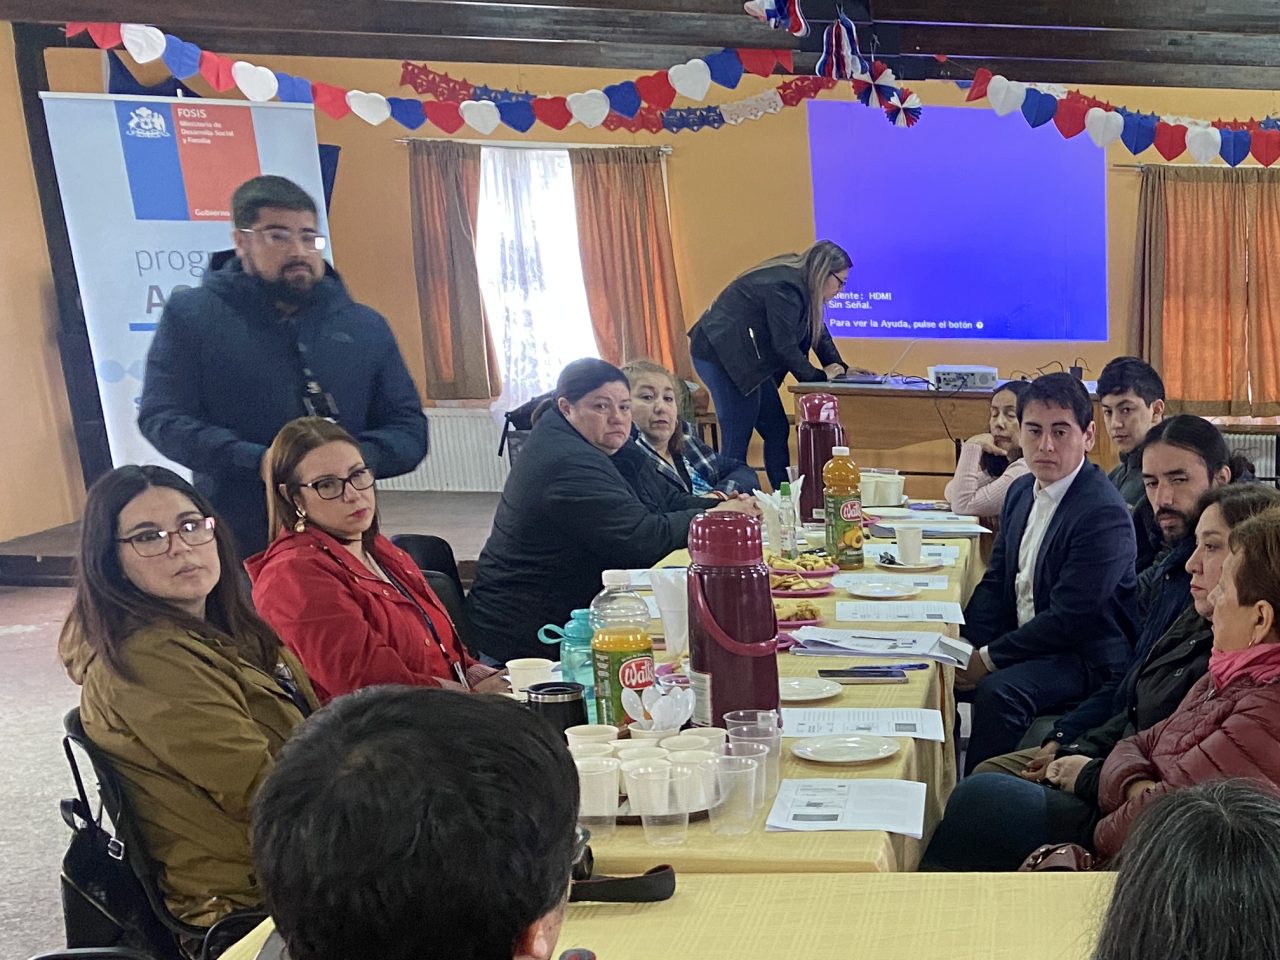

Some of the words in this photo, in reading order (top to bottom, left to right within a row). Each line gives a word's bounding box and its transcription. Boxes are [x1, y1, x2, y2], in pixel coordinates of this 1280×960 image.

[177, 107, 207, 119] FOSIS
[194, 208, 231, 217] Gobierno
[135, 249, 209, 277] prog
[869, 292, 892, 301] HDMI
[828, 300, 843, 309] Sin
[829, 318, 851, 328] Para
[853, 320, 867, 328] ver
[870, 319, 878, 328] la
[881, 319, 911, 330] Ayuda,
[913, 319, 936, 329] pulse
[939, 320, 946, 329] el
[949, 320, 973, 329] botón
